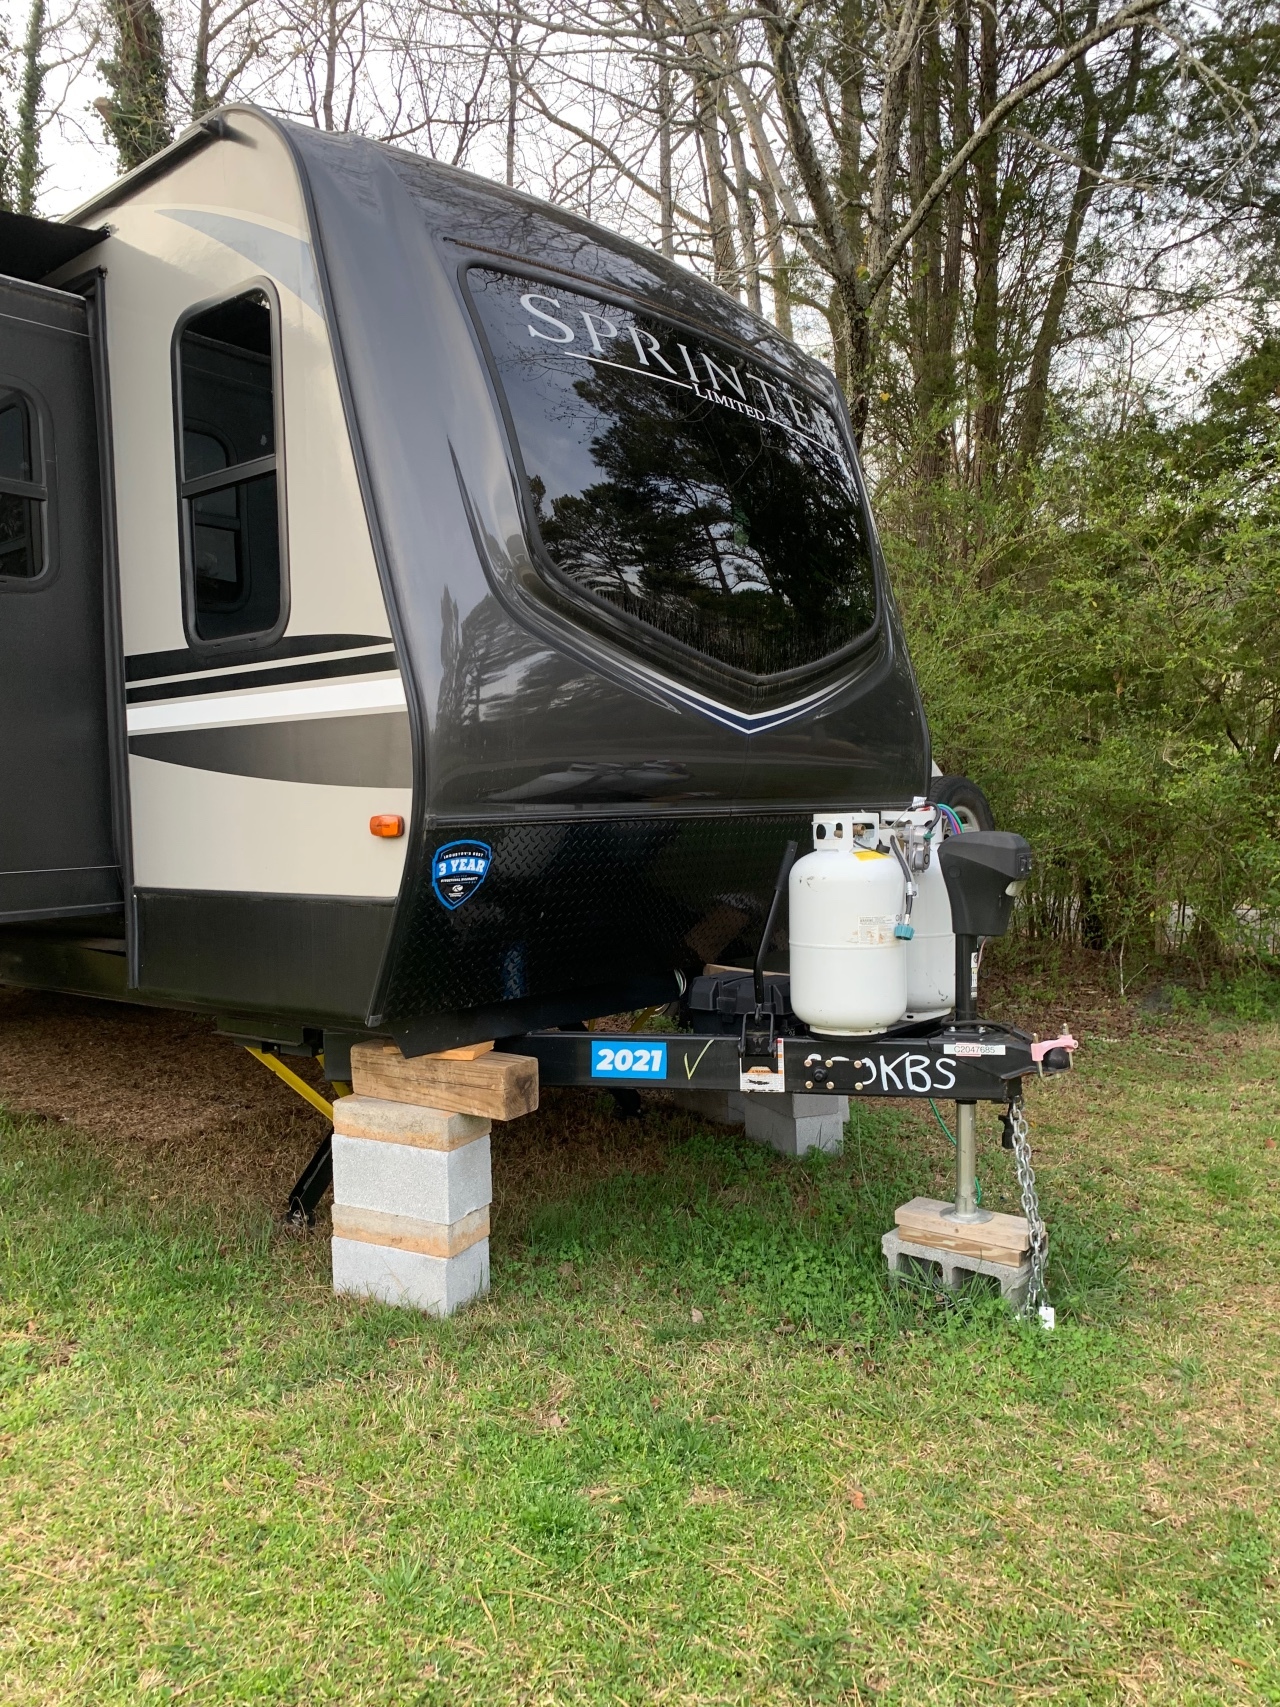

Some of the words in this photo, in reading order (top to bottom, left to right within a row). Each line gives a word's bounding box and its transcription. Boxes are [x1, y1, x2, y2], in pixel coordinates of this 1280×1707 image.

[693, 382, 766, 422] LIMITED
[438, 862, 447, 875] 3
[450, 858, 486, 872] YEAR
[595, 1048, 663, 1072] 2021
